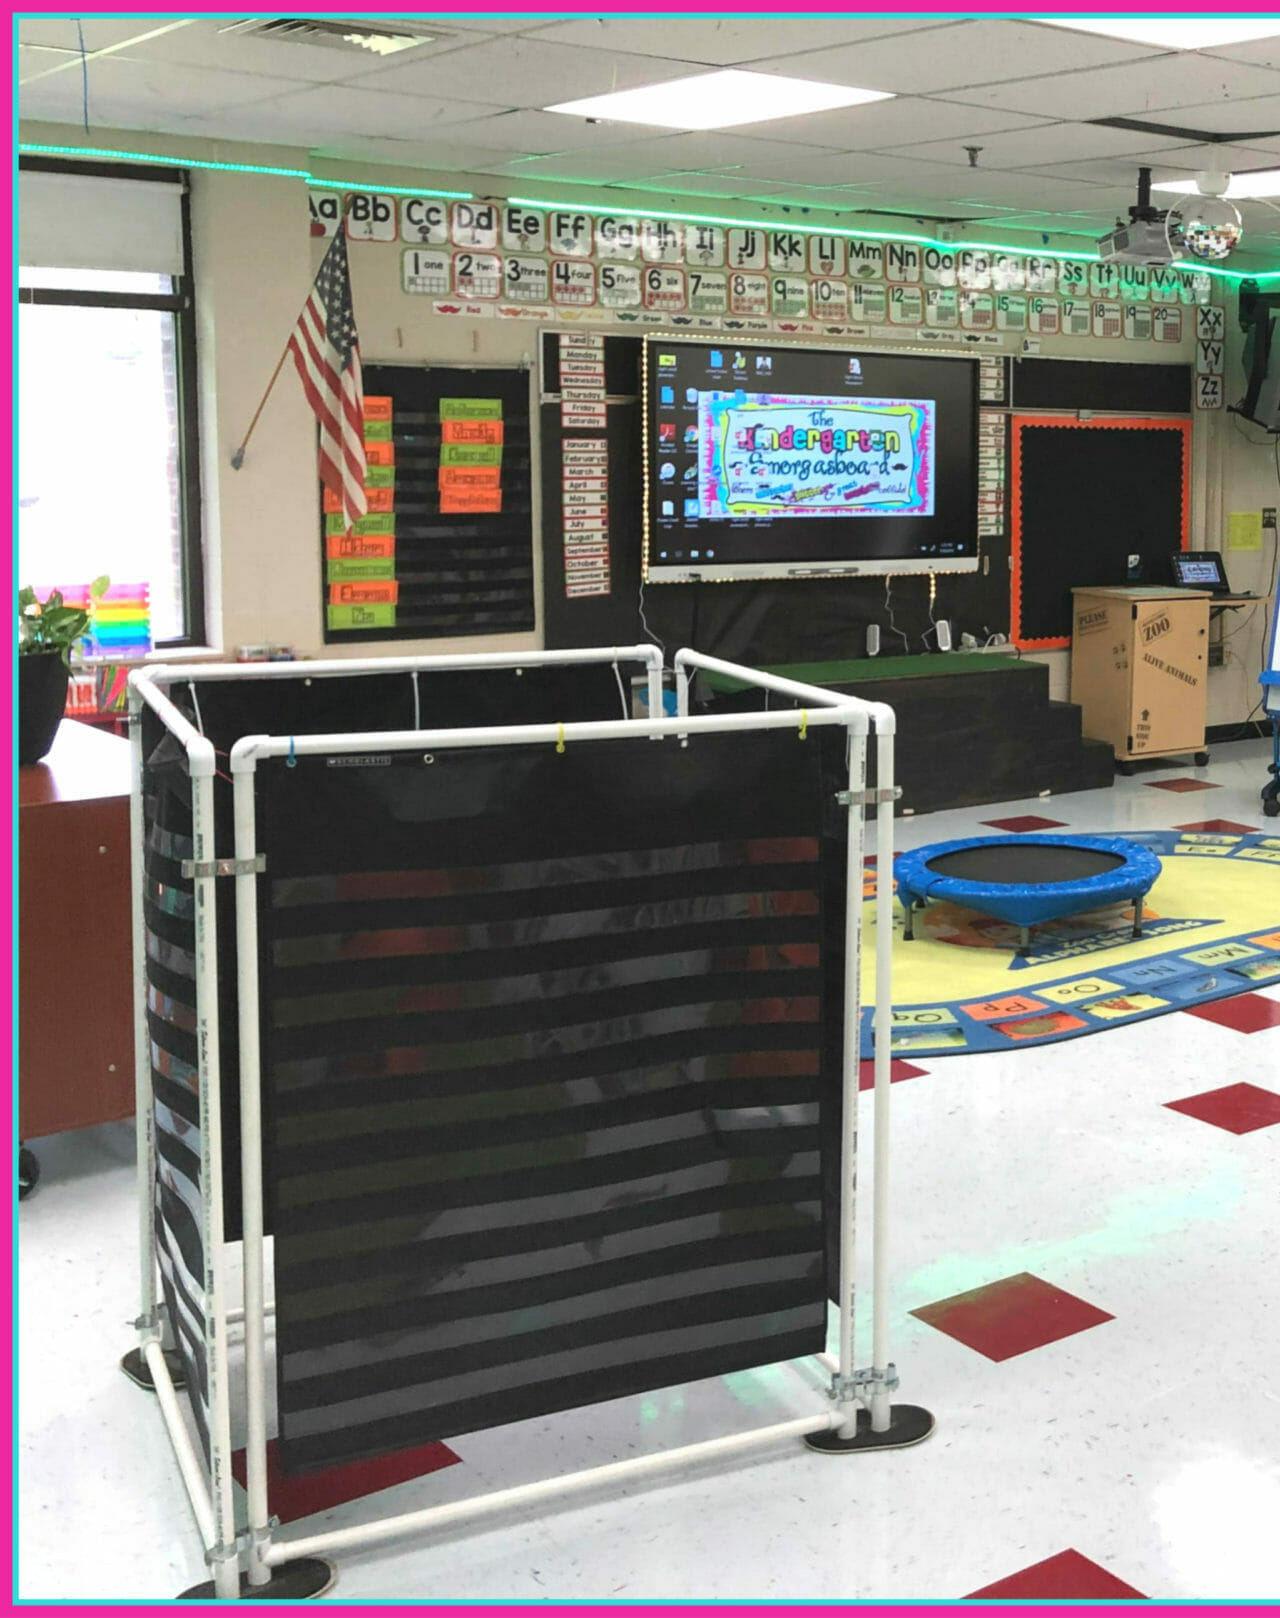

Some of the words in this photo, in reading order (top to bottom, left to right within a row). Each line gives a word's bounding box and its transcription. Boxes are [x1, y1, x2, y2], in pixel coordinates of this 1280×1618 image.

[352, 195, 391, 222] Bb
[406, 200, 441, 226] Cc
[457, 204, 493, 231] Dd
[506, 208, 540, 235] Ee
[555, 214, 585, 238] Ff
[600, 217, 634, 248] Gg
[645, 222, 678, 249] Hh
[695, 226, 714, 251] Ii
[742, 230, 756, 258] Jj
[773, 233, 801, 260] Kk
[818, 236, 835, 261] Ll
[850, 241, 882, 261] Mm
[889, 245, 917, 268] Nn
[925, 249, 953, 270] Oo
[1029, 257, 1051, 279] Rr
[1063, 264, 1083, 283] Ss
[1096, 264, 1113, 283] Tt
[1123, 266, 1145, 286] Uu
[1154, 269, 1176, 288] Vv
[413, 253, 419, 275] 1
[424, 260, 444, 271] one
[458, 256, 473, 276] 2
[476, 261, 496, 272] two
[507, 260, 521, 281] 3
[521, 267, 546, 278] three
[556, 263, 570, 284] 4
[571, 269, 593, 281] four
[602, 268, 615, 289] 5
[649, 269, 661, 290] 6
[665, 276, 679, 286] six
[690, 275, 701, 295] 7
[702, 282, 726, 290] seven
[734, 275, 746, 295] 8
[774, 280, 787, 300] 9
[815, 281, 832, 301] 10
[854, 285, 863, 304] 11
[892, 287, 904, 303] 12
[998, 296, 1010, 311] 15
[1031, 298, 1043, 313] 16
[1064, 301, 1074, 317] 17
[1095, 303, 1105, 318] 18
[1125, 306, 1136, 320] 19
[1155, 308, 1167, 320] 20
[1200, 308, 1221, 326] Xx
[568, 335, 596, 345] Sundy
[566, 351, 597, 360] Monday
[1201, 343, 1221, 365] Yy
[568, 364, 597, 373] Tuesday
[563, 377, 602, 385] Wednesday
[1201, 377, 1218, 396] Zz
[566, 391, 600, 400] Thursday
[572, 404, 596, 412] Friday
[568, 417, 600, 425] Saturday
[808, 409, 834, 426] The
[565, 441, 596, 449] January
[738, 425, 900, 453] Kndergarten
[565, 455, 600, 463] February
[749, 451, 890, 480] Smorgasboad
[569, 481, 587, 489] April
[569, 495, 586, 503] May
[568, 533, 594, 542] August
[567, 560, 598, 568] October
[1143, 617, 1170, 641] ZOO
[1144, 653, 1164, 670] ALIVE
[1165, 664, 1198, 686] ANIMALS
[1198, 946, 1248, 960] Mm
[1057, 984, 1100, 996] Oo
[983, 1002, 1028, 1013] Pp
